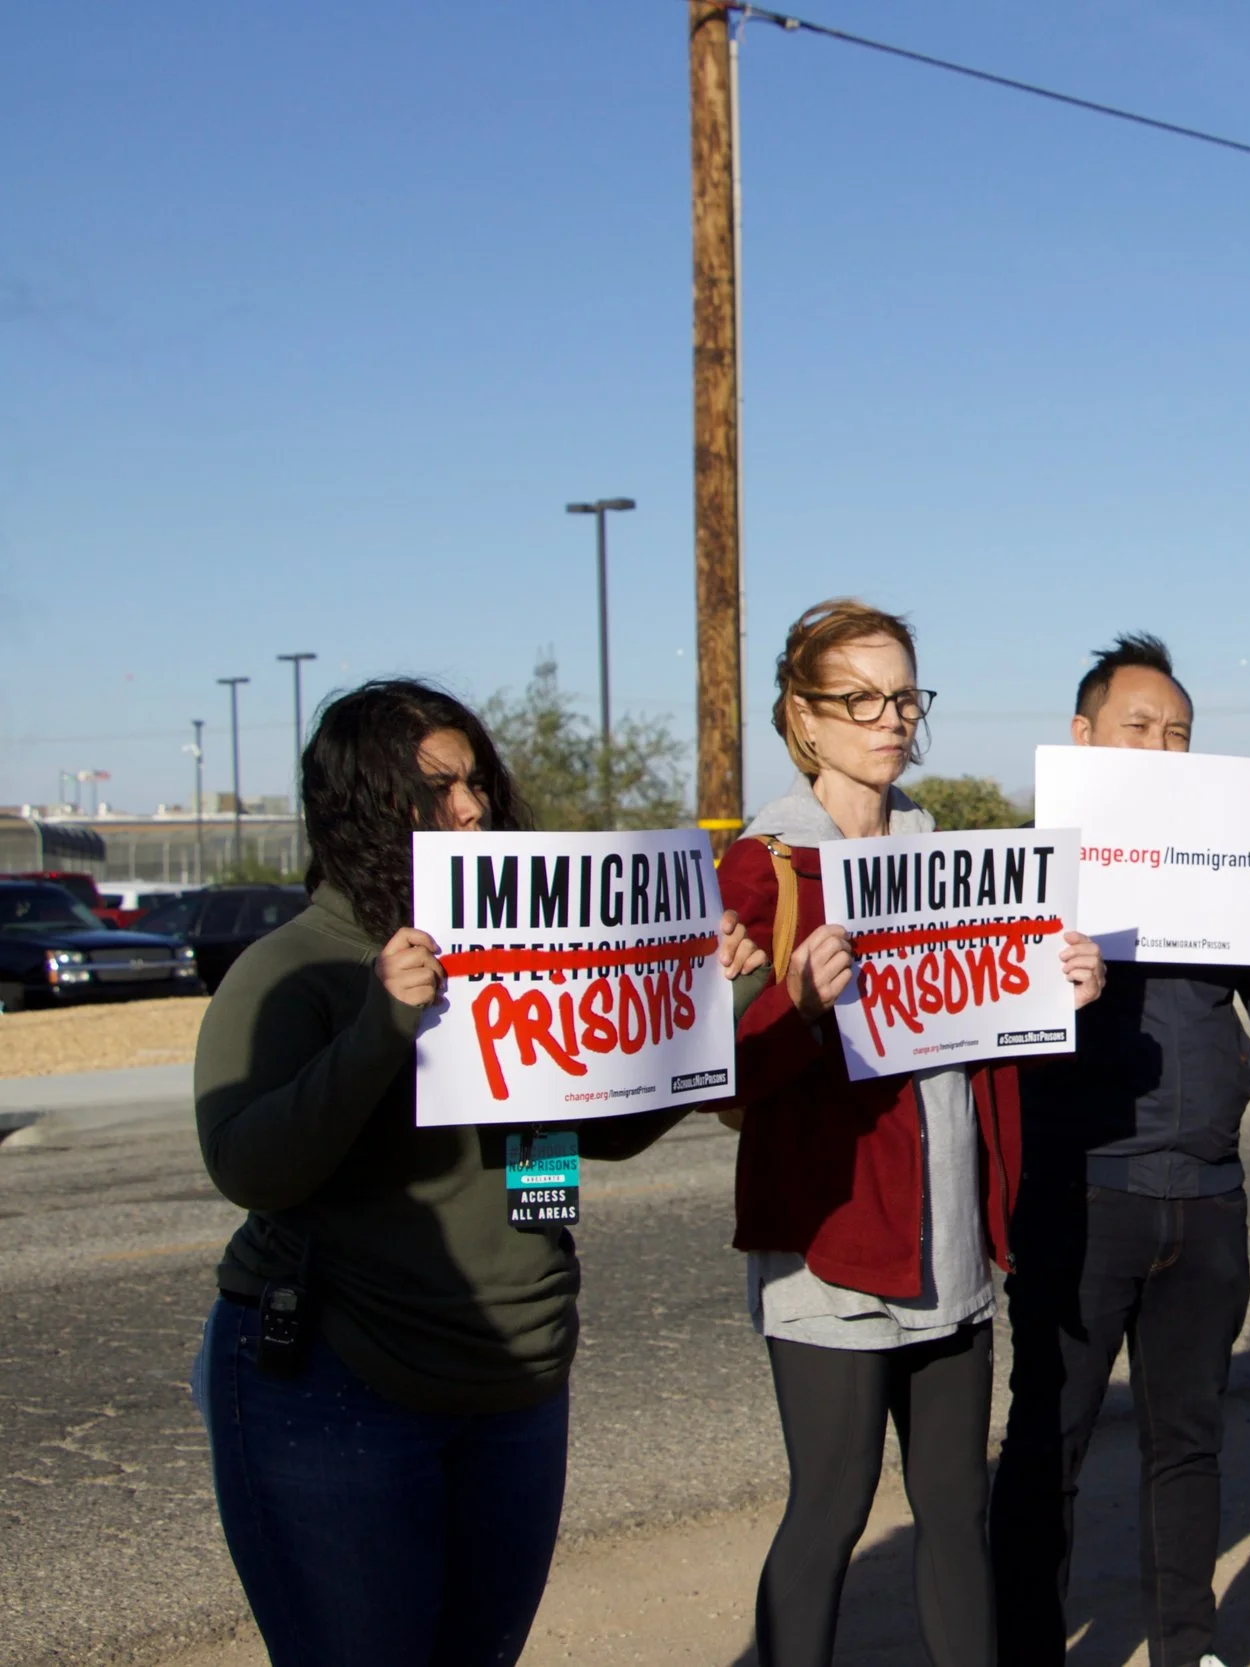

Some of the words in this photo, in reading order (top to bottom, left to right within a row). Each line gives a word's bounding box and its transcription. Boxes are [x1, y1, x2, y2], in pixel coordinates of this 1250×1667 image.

[450, 849, 707, 929] IMMIGRANT
[843, 846, 1055, 920] IMMIGRANT
[956, 914, 1057, 950] CENTS"
[634, 930, 716, 976] CENTS"
[511, 1208, 534, 1221] ALL
[538, 1206, 577, 1220] AREAS
[520, 1189, 566, 1203] ACCESS
